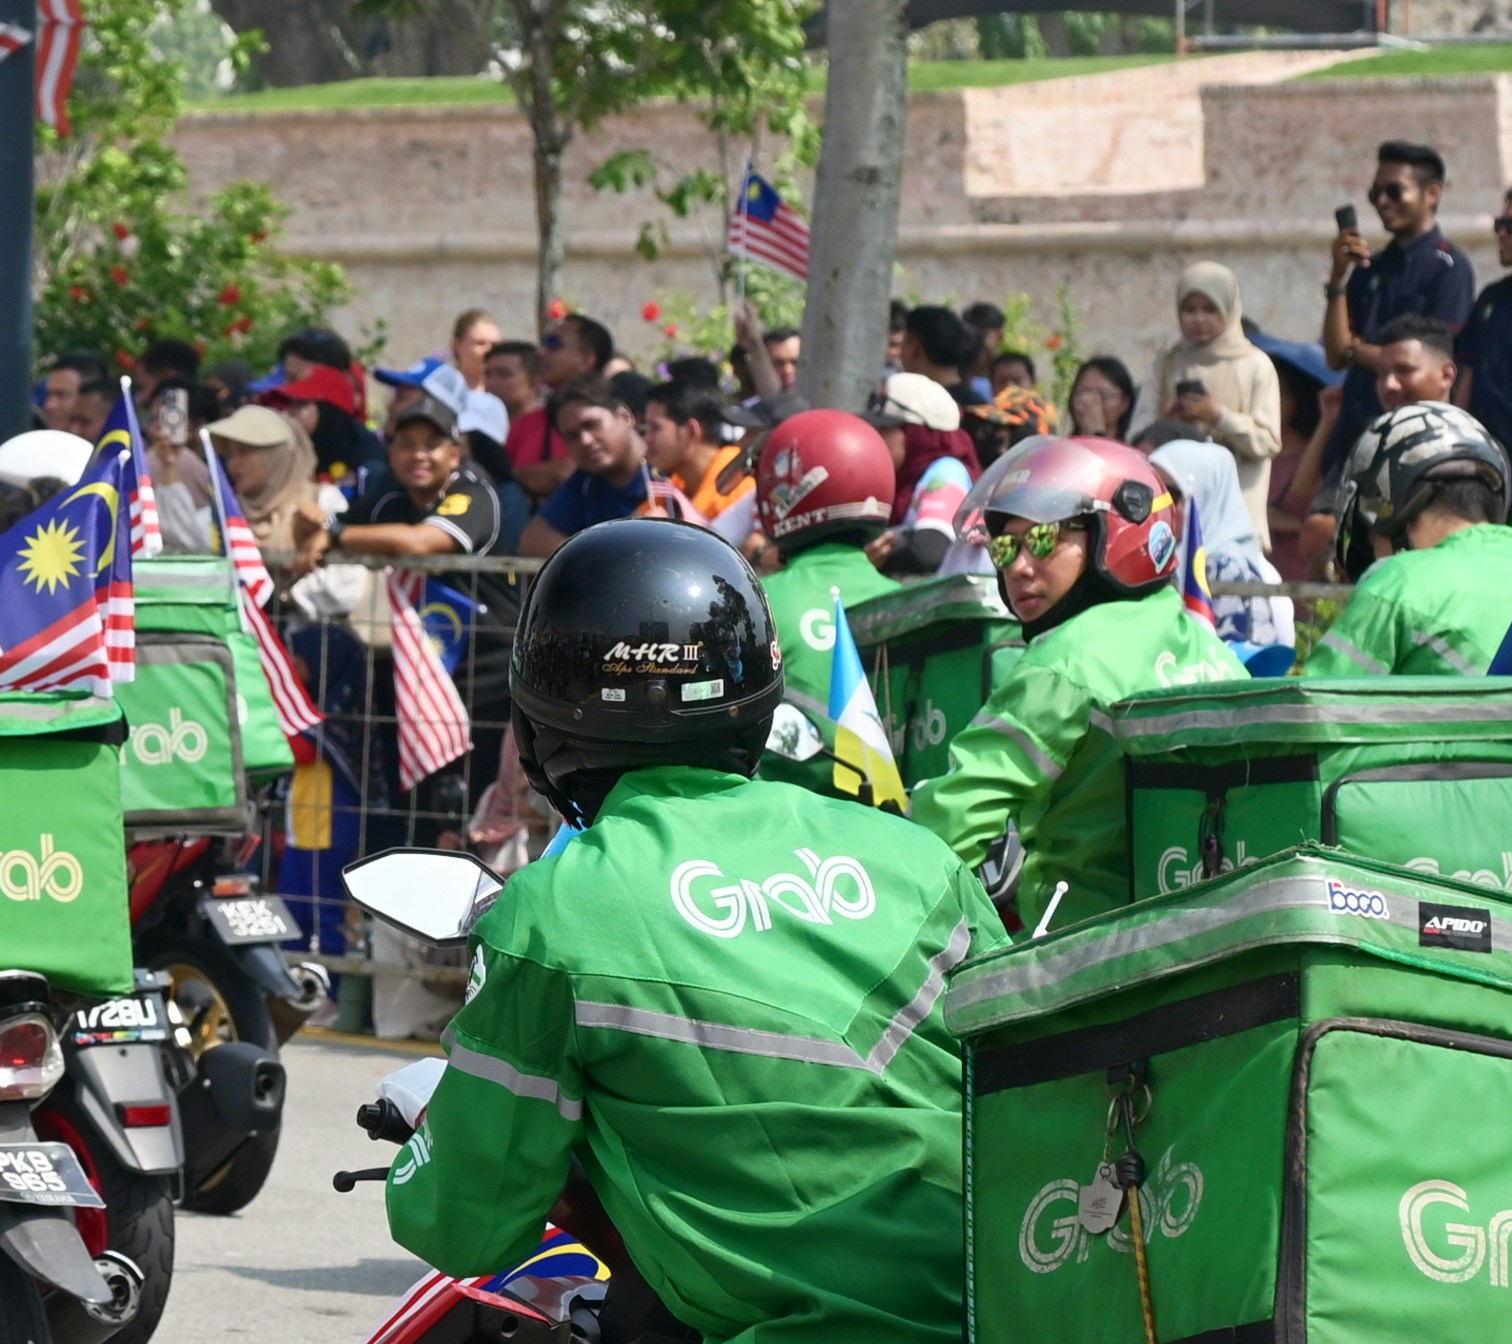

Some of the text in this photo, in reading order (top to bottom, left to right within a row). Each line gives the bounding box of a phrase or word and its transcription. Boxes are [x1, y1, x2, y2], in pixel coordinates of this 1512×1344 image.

[773, 507, 827, 538] KENT
[635, 660, 699, 675] Standard
[120, 708, 208, 764] ab
[669, 847, 876, 940] Grab
[1425, 916, 1484, 934] APIDO
[1, 1170, 68, 1192] 965
